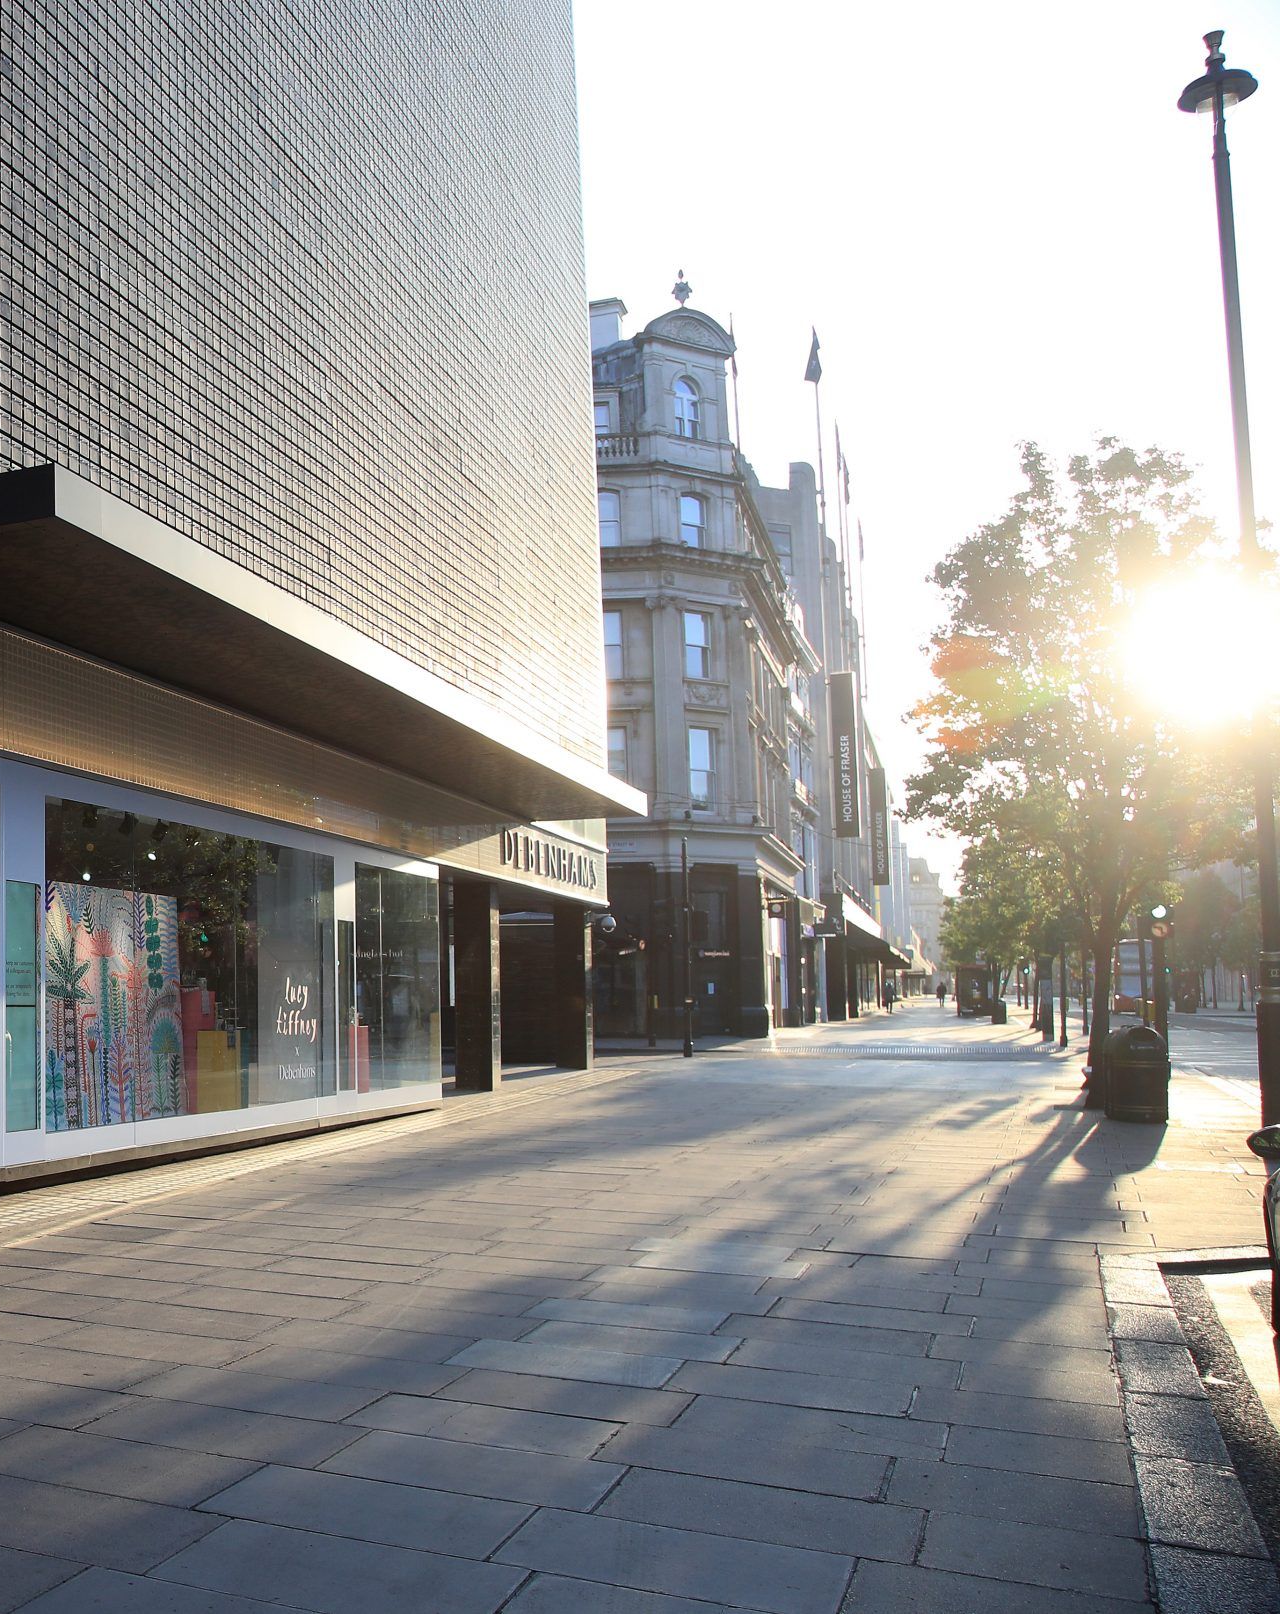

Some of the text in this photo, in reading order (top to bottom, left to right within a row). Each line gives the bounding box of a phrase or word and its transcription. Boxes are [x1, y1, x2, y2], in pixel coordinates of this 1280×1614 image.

[840, 735, 853, 822] HOUSE OF FRASER
[500, 829, 597, 890] DEBENHAMS
[285, 976, 308, 1011] lucy
[276, 1006, 317, 1043] tiffney
[278, 1063, 317, 1080] Debenhams
